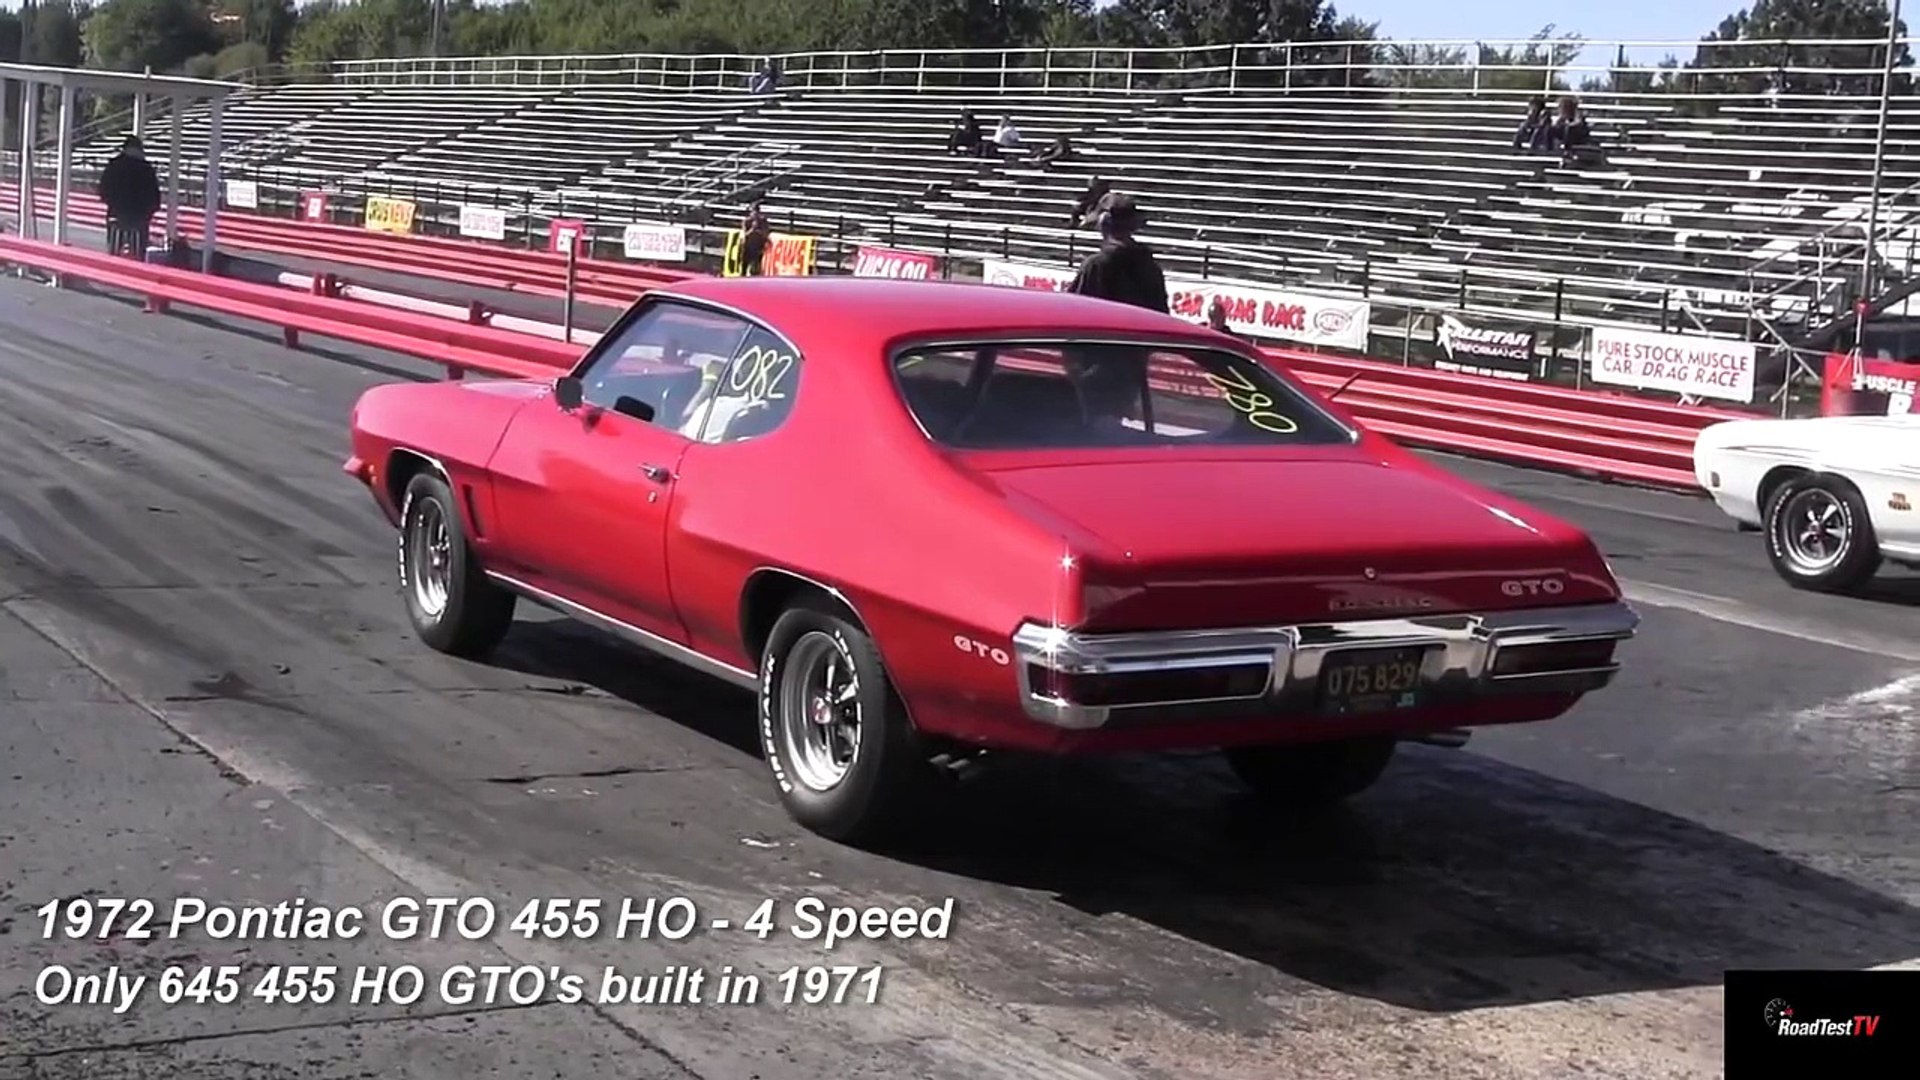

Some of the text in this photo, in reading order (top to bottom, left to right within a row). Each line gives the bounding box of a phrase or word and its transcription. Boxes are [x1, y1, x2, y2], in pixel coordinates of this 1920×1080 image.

[1172, 292, 1205, 317] CAR
[1263, 300, 1306, 331] RACE
[1597, 339, 1748, 372] PURE STOCK MUSCLE
[731, 345, 793, 402] 082
[1602, 356, 1740, 388] CAR DRAG RACE
[1500, 579, 1565, 597] GTO
[953, 634, 1010, 666] GTO
